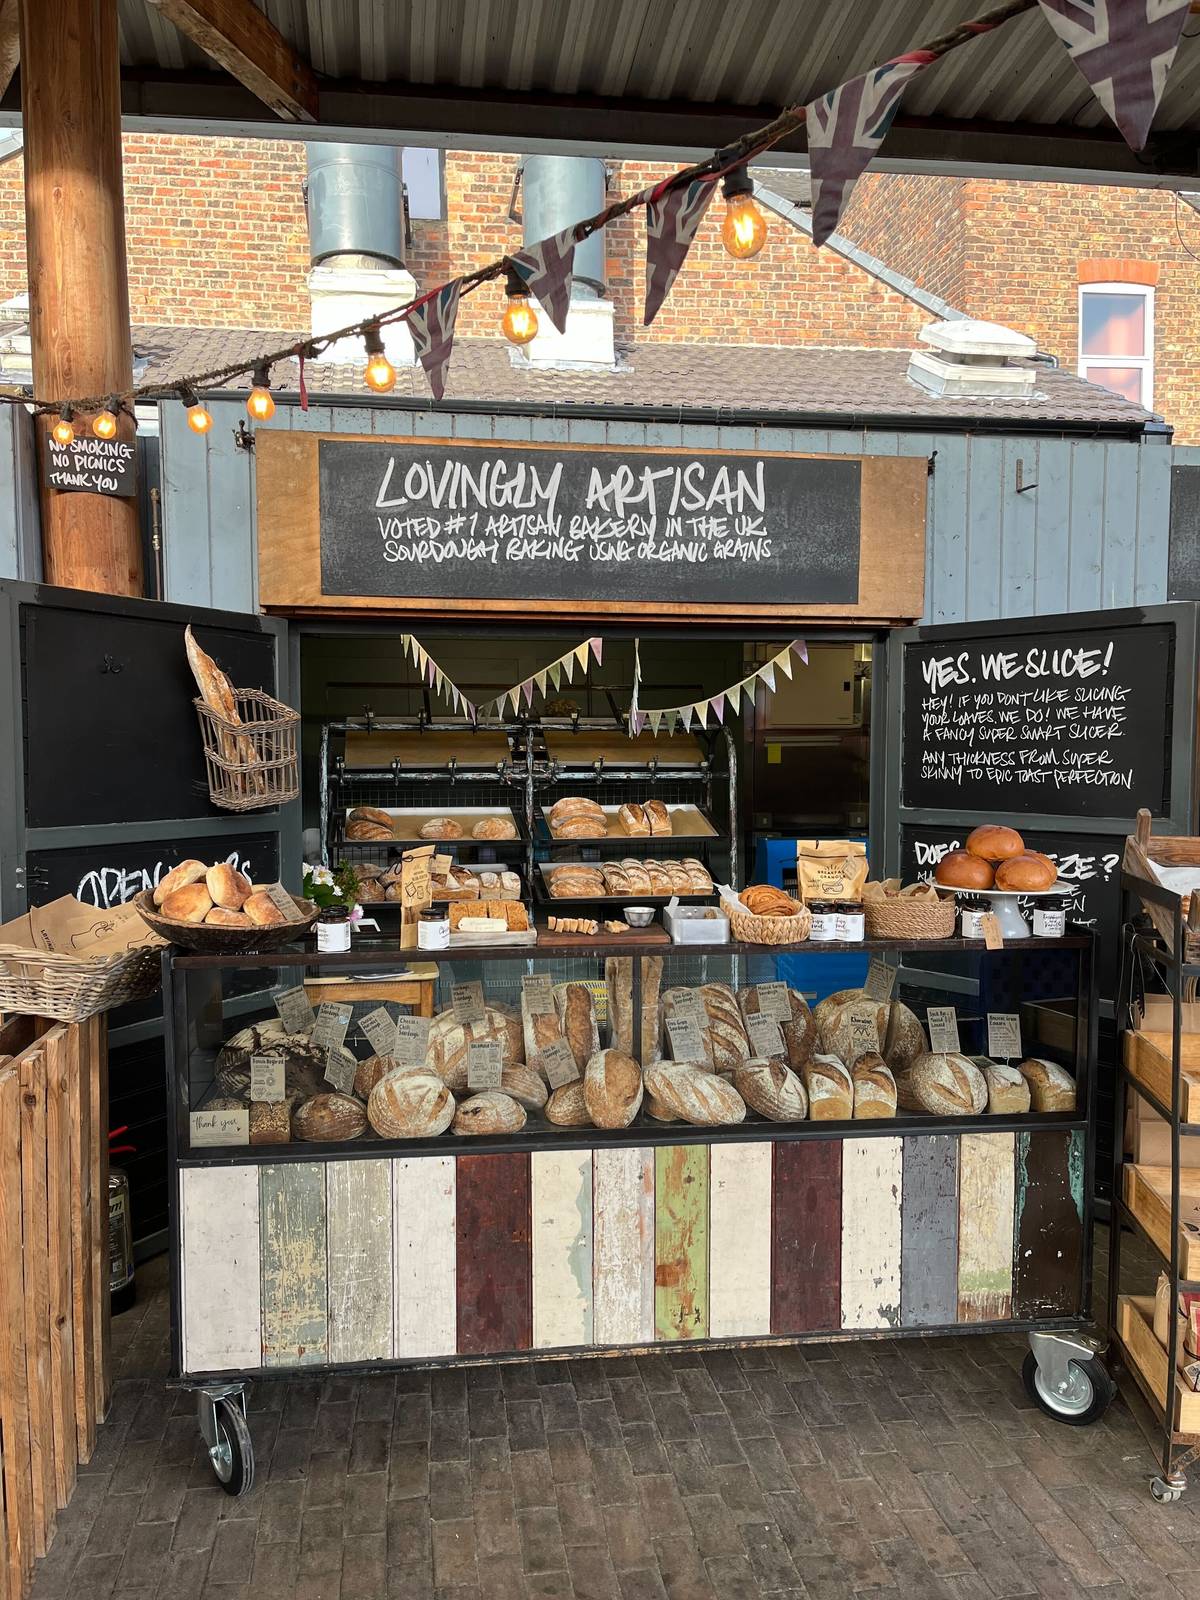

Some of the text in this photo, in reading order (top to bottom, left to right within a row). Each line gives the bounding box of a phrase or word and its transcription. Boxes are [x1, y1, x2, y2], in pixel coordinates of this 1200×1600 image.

[49, 440, 134, 459] NO SMOKING
[52, 454, 126, 473] NO PICNICS
[50, 472, 118, 492] THANK YOU
[376, 457, 765, 524] LOVINGLY ARTISAN
[378, 516, 441, 540] VOTED
[485, 514, 562, 539] ARTISAN
[569, 513, 656, 543] BAKERY
[665, 516, 682, 537] IN
[686, 516, 730, 540] THE
[734, 515, 768, 536] UK
[383, 536, 771, 564] SOURDOUGH BAKING USING ORGANIC GRAINS
[922, 641, 1114, 694] YES. WE SLICE!
[922, 694, 954, 715] HEY!
[958, 695, 971, 708] IF
[974, 694, 994, 710] YOU
[1033, 688, 1071, 703] LIKE
[1074, 685, 1132, 702] SLICING
[922, 711, 950, 731] YOUR
[998, 710, 1021, 724] WE
[1026, 707, 1050, 722] DO!
[1056, 706, 1080, 720] WE
[1083, 706, 1127, 721] HAVE
[923, 729, 932, 741] A
[935, 727, 975, 747] FANCY
[979, 726, 1017, 743] SUPER
[1020, 724, 1066, 741] SMART
[922, 748, 1114, 770] ANY THICKNESS FROM SUPER
[920, 765, 962, 785] SKINNY
[966, 768, 983, 779] TO
[986, 768, 1012, 785] EPIC
[1015, 768, 1052, 783] TOAST
